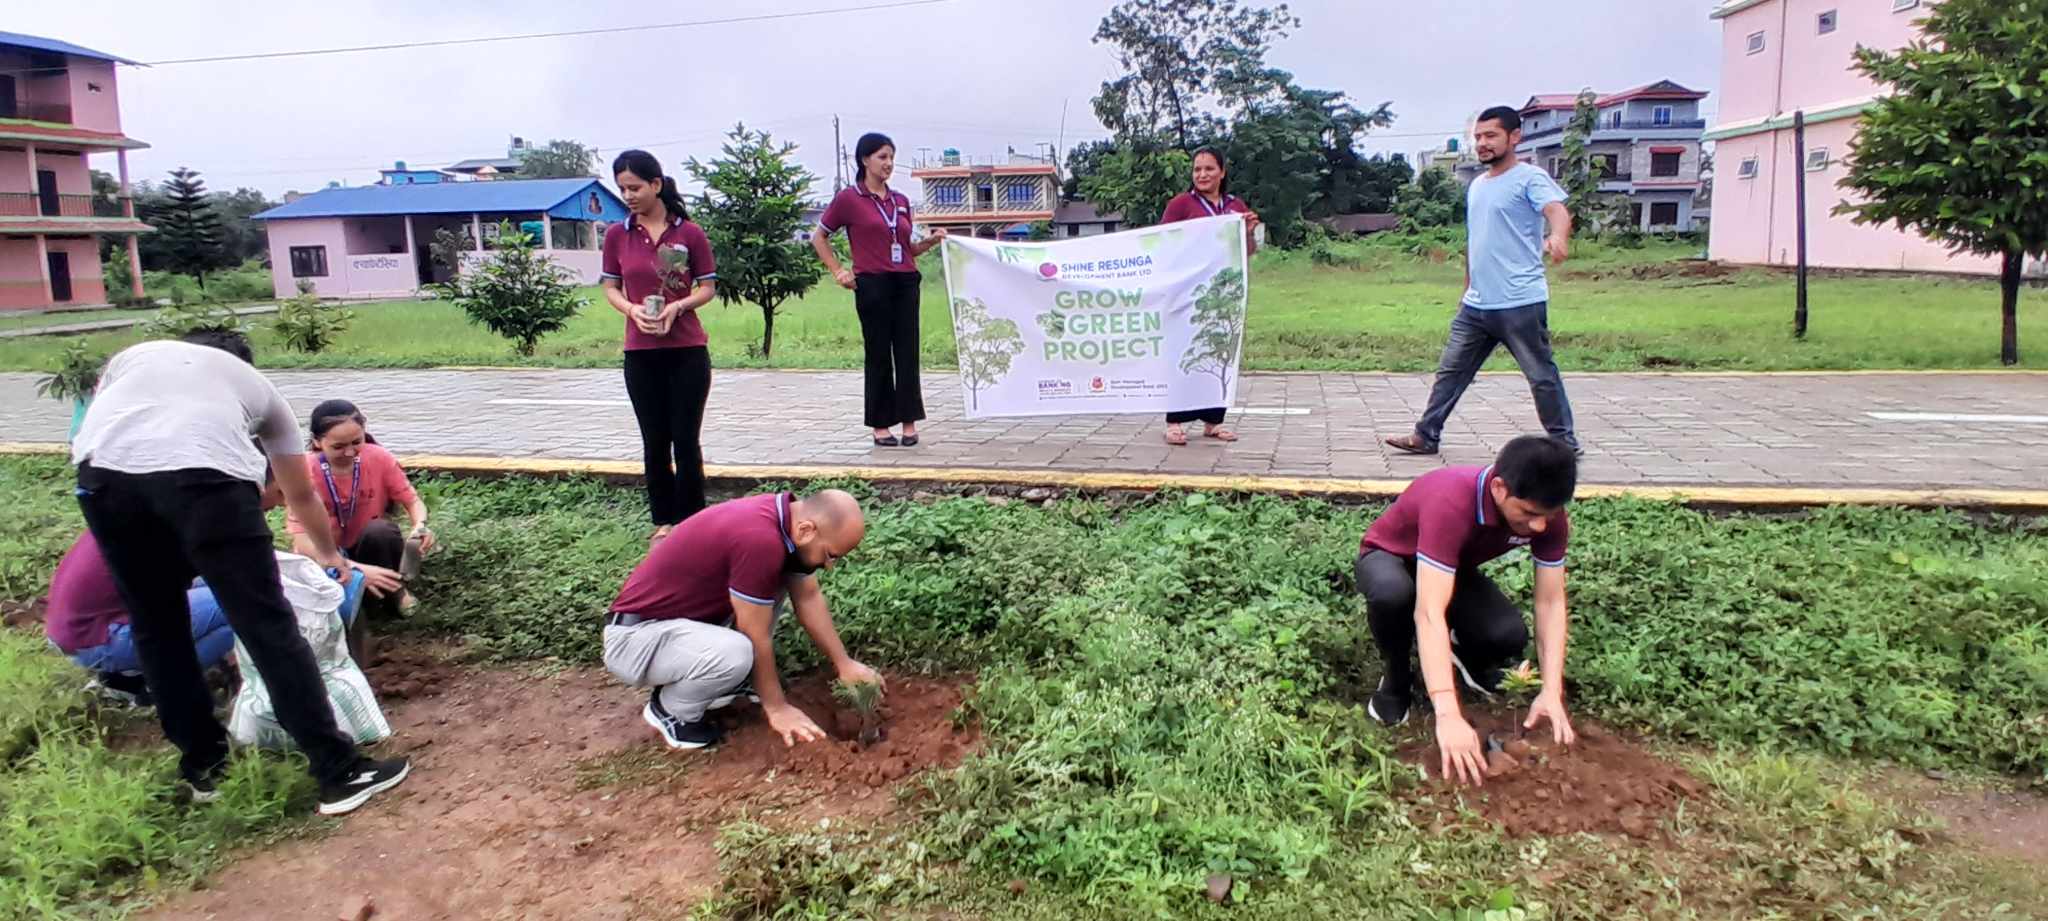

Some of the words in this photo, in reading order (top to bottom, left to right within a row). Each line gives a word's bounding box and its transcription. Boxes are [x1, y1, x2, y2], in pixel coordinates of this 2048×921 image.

[1061, 262, 1094, 273] SHINE
[1098, 255, 1153, 271] RESUNGA
[1117, 270, 1137, 278] BANK
[1055, 287, 1143, 309] GROW
[1068, 311, 1160, 335] GREEN
[1043, 336, 1164, 365] PROJECT
